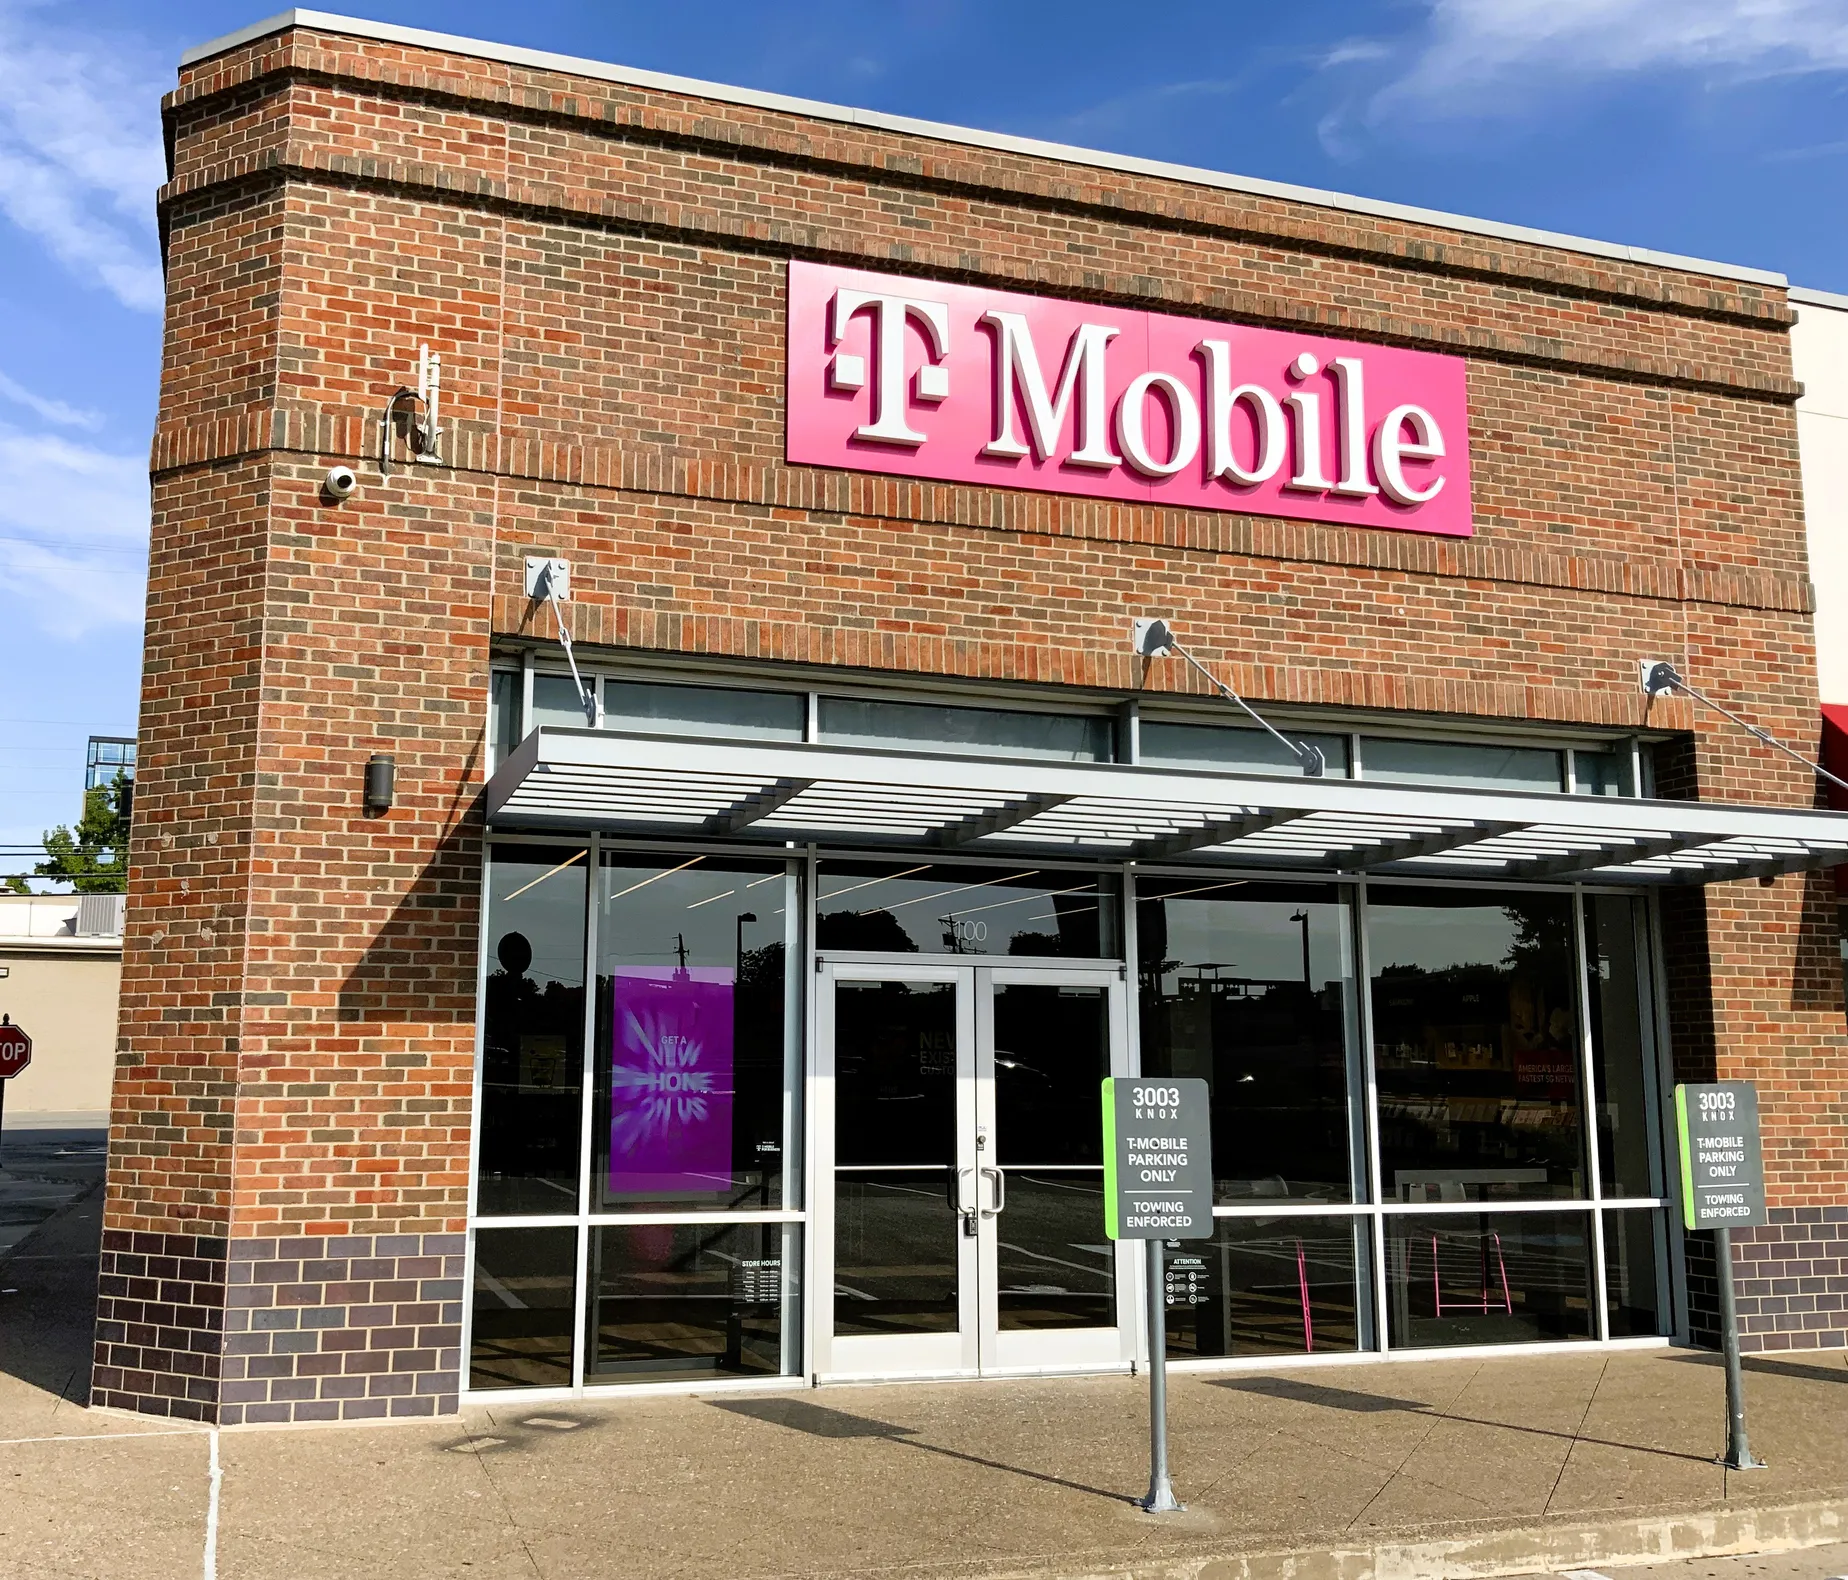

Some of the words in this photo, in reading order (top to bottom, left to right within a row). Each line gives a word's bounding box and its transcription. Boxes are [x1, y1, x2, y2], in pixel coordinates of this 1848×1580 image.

[980, 309, 1447, 505] Mobile
[954, 920, 987, 941] 100
[661, 1035, 679, 1044] GET
[680, 1035, 687, 1044] A
[0, 1042, 26, 1060] OP
[1132, 1087, 1180, 1106] 3003
[1699, 1092, 1735, 1110] 3003
[1135, 1108, 1178, 1119] KNOX
[1702, 1111, 1734, 1121] KNOX
[1126, 1137, 1188, 1150] T-MOBILE
[1697, 1136, 1744, 1149] T-MOBILE
[1128, 1154, 1188, 1166] PARKING
[1699, 1151, 1745, 1163] PARKING
[1140, 1169, 1176, 1182] ONLY
[1709, 1165, 1737, 1178] ONLY
[1705, 1193, 1744, 1205] TOWING
[1133, 1201, 1184, 1213] TOWING
[1701, 1206, 1751, 1219] ENFORCED
[1126, 1215, 1192, 1228] ENFORCED
